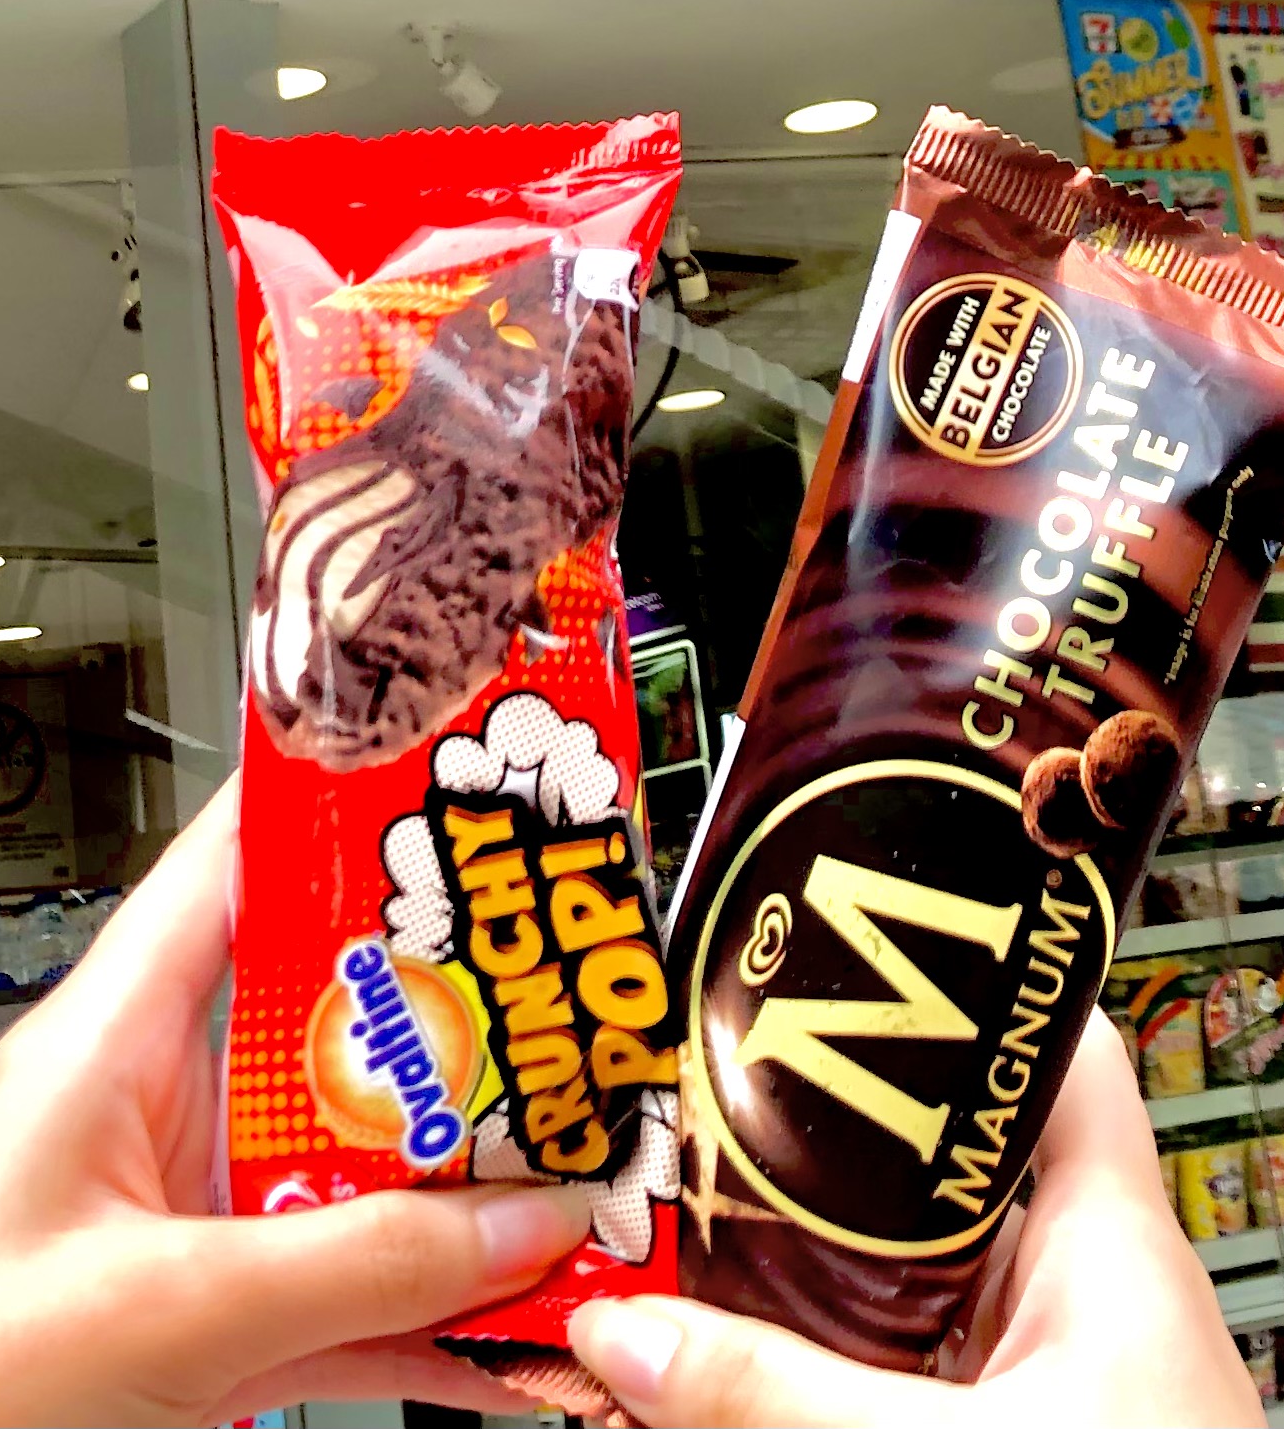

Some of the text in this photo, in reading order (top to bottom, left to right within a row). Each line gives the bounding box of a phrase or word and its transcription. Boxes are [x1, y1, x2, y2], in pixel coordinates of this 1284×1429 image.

[920, 296, 980, 411] MADE WITH
[939, 288, 1031, 451] BELGIAN
[990, 324, 1052, 443] CHOCOLATE
[961, 346, 1157, 751] CHOCOLATE
[1042, 428, 1190, 706] TRUFFLE
[342, 944, 463, 1162] Ovaltine
[445, 804, 610, 1173] CRUNCHY
[539, 831, 680, 1091] POP!
[733, 853, 1023, 1164] M
[933, 888, 1092, 1215] MAGNUM
